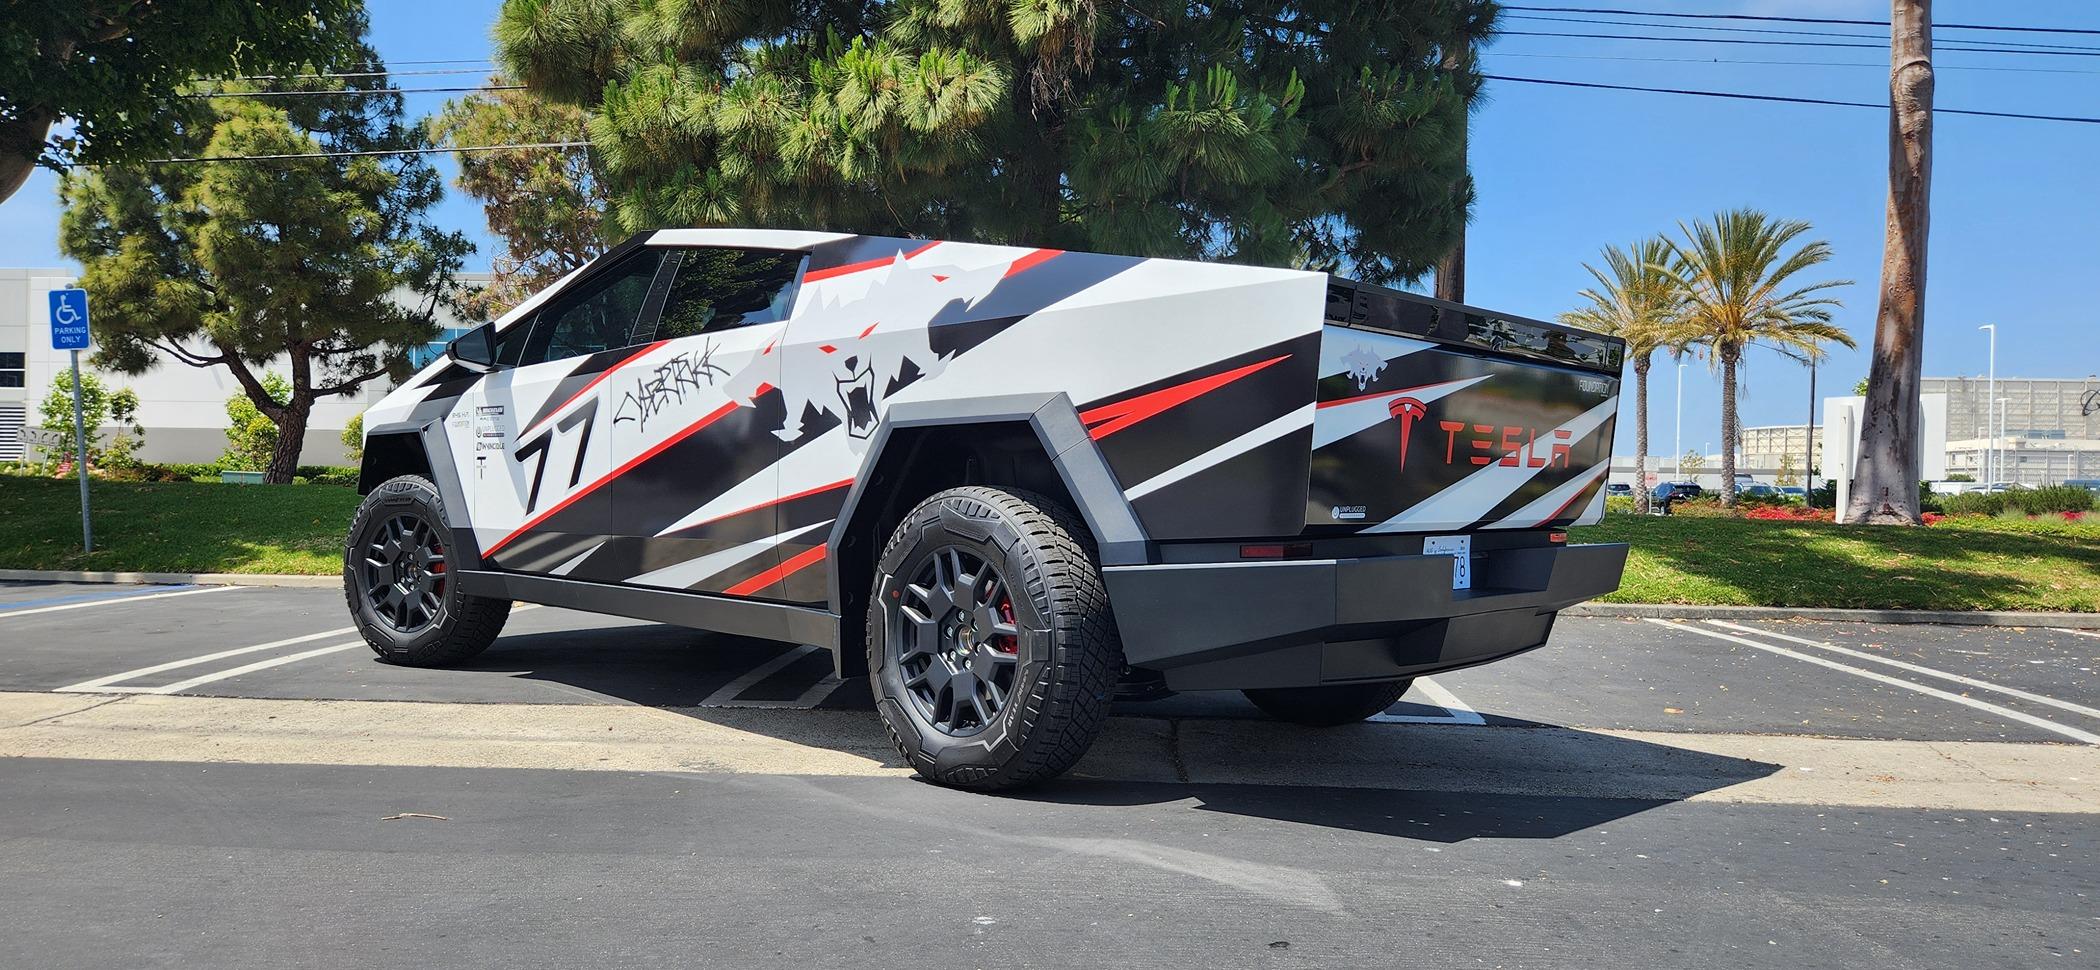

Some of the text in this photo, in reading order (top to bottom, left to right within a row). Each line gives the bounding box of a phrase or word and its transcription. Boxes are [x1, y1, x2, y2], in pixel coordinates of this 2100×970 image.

[54, 326, 86, 334] PARKING
[60, 335, 80, 343] ONLY
[1439, 420, 1573, 469] TESLA
[514, 395, 600, 517] 77
[1339, 505, 1367, 513] UNPLUGGED
